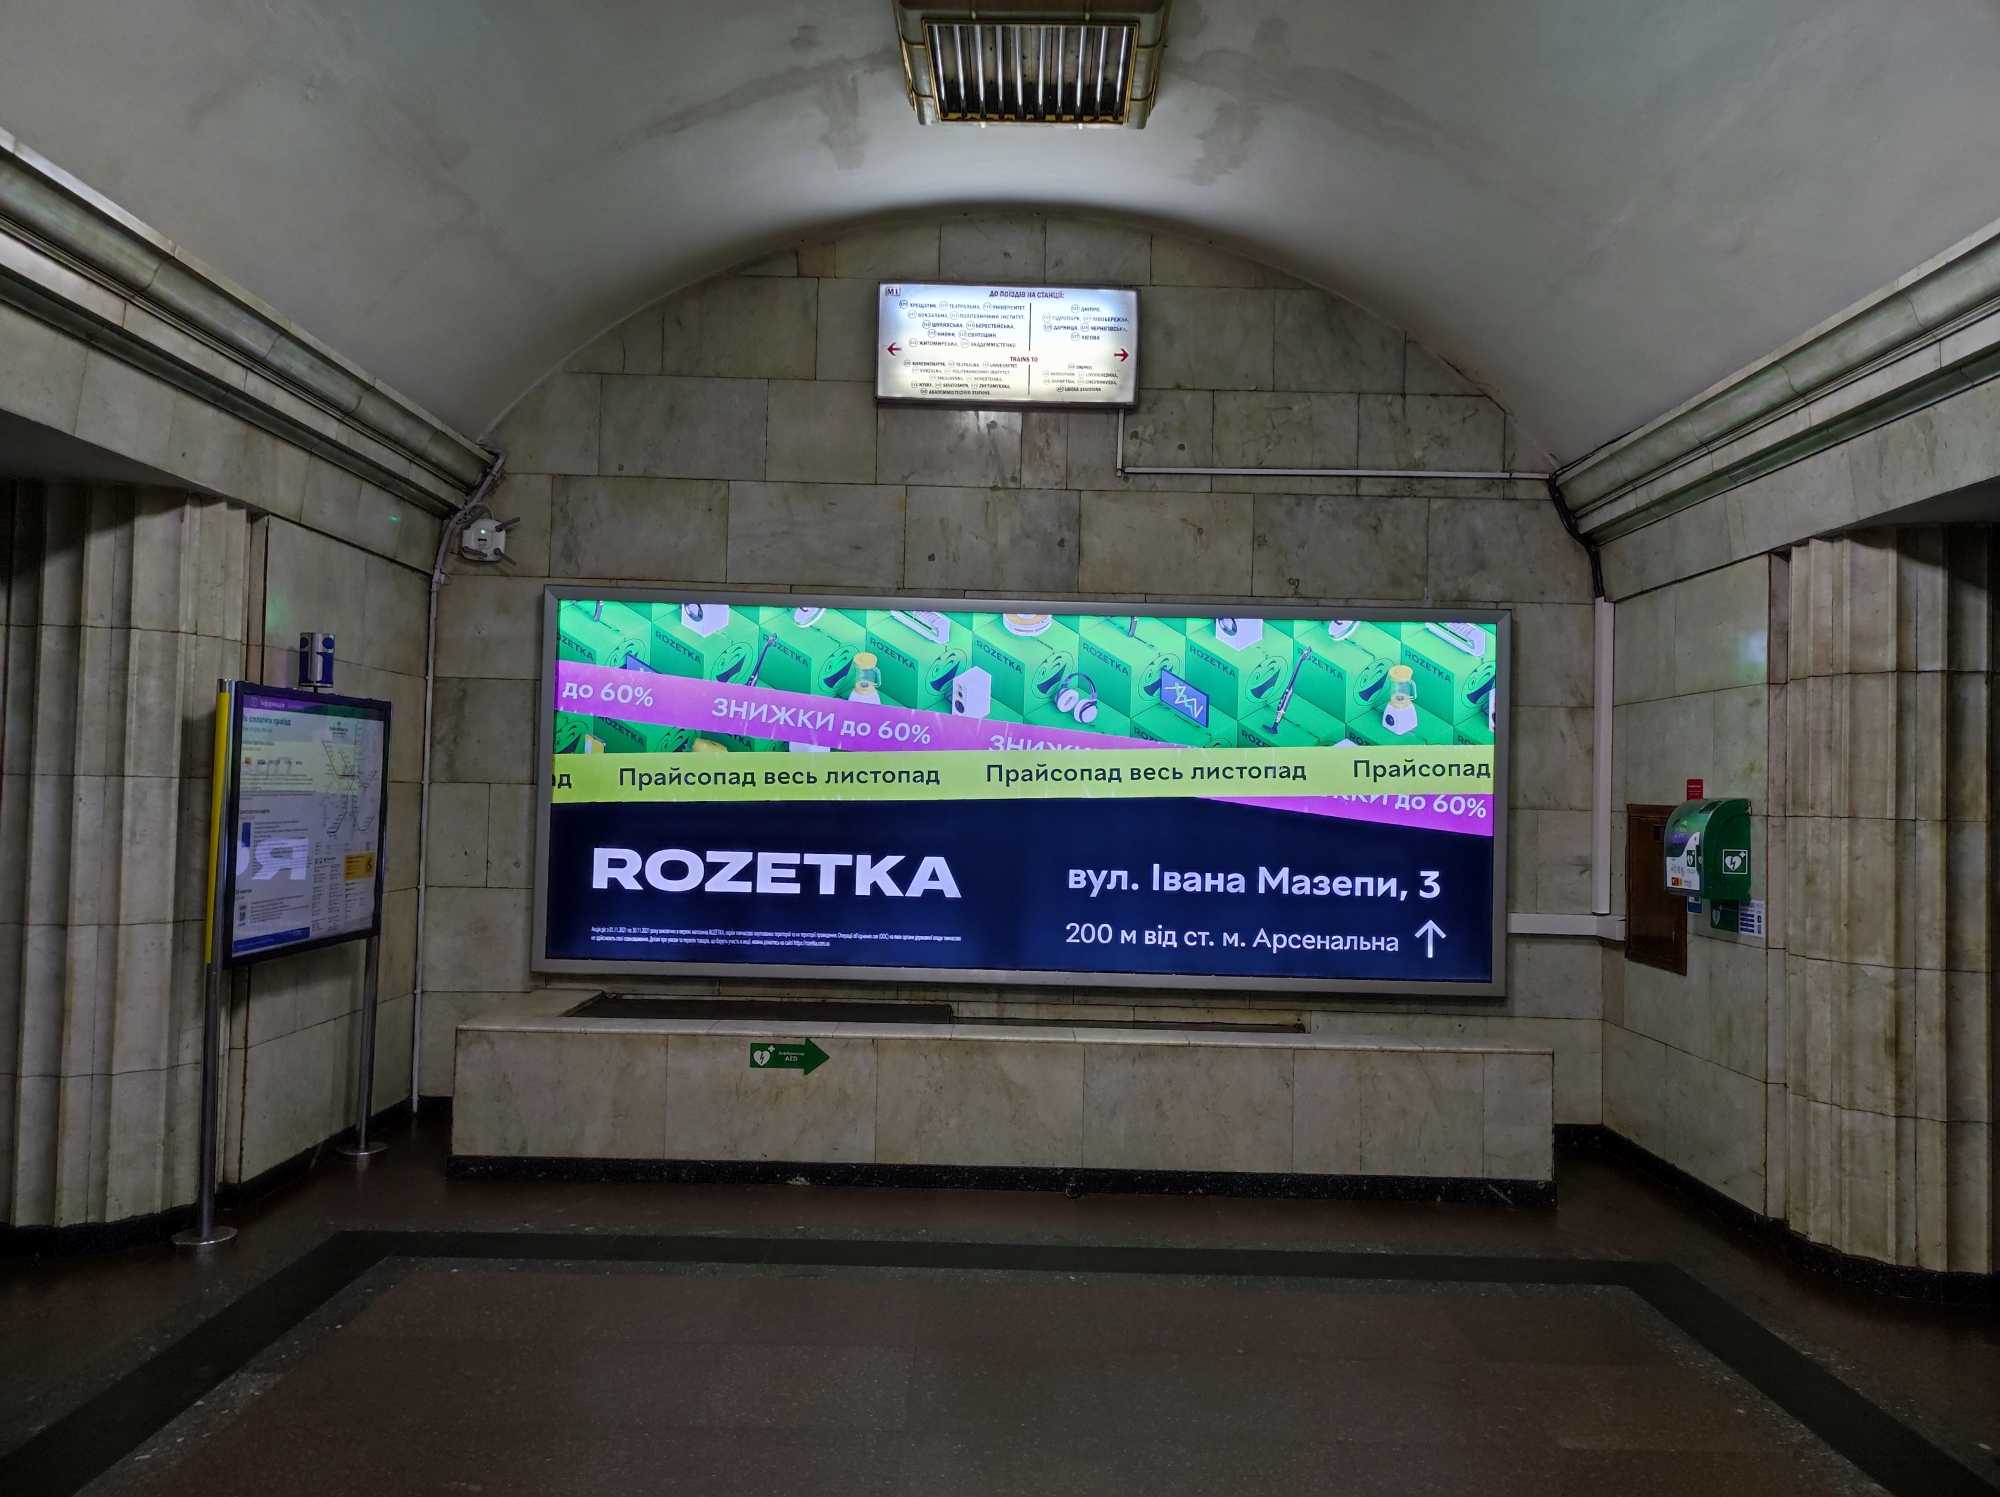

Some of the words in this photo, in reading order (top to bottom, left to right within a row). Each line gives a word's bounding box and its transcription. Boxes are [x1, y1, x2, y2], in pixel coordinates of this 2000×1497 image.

[655, 629, 702, 665] ROZETKA
[869, 636, 916, 672] ROZETKA
[976, 640, 1023, 674] ROZETKA
[1082, 642, 1129, 677] ROZETKA
[1189, 644, 1236, 678] ROZETKA
[1405, 649, 1452, 684] ROZETKA
[562, 682, 594, 699] до
[600, 683, 654, 707] 60%
[712, 698, 834, 732] ЗНИЖКИ
[840, 720, 871, 737] до
[878, 720, 931, 744] 60%
[988, 734, 1100, 750] ЗНИ
[619, 767, 756, 791] Прайсопад
[764, 770, 818, 785] весь
[825, 768, 940, 785] листопад
[986, 762, 1122, 787] Прайсопад
[1130, 767, 1183, 781] весь
[1191, 765, 1307, 780] листопад
[1354, 758, 1491, 782] Прайсопад
[1395, 795, 1426, 810] до
[1432, 794, 1487, 818] 60%
[592, 847, 962, 898] ROZETKA
[1068, 868, 1139, 897] вул.
[1152, 864, 1245, 894] Івана
[1258, 866, 1408, 901] Мазепи,
[1419, 871, 1441, 899] 3
[1065, 923, 1113, 944] 200
[1121, 930, 1137, 945] м
[1144, 925, 1177, 948] від
[1183, 931, 1214, 948] ст.
[1222, 932, 1245, 948] м.
[1253, 928, 1399, 954] Арсенальна
